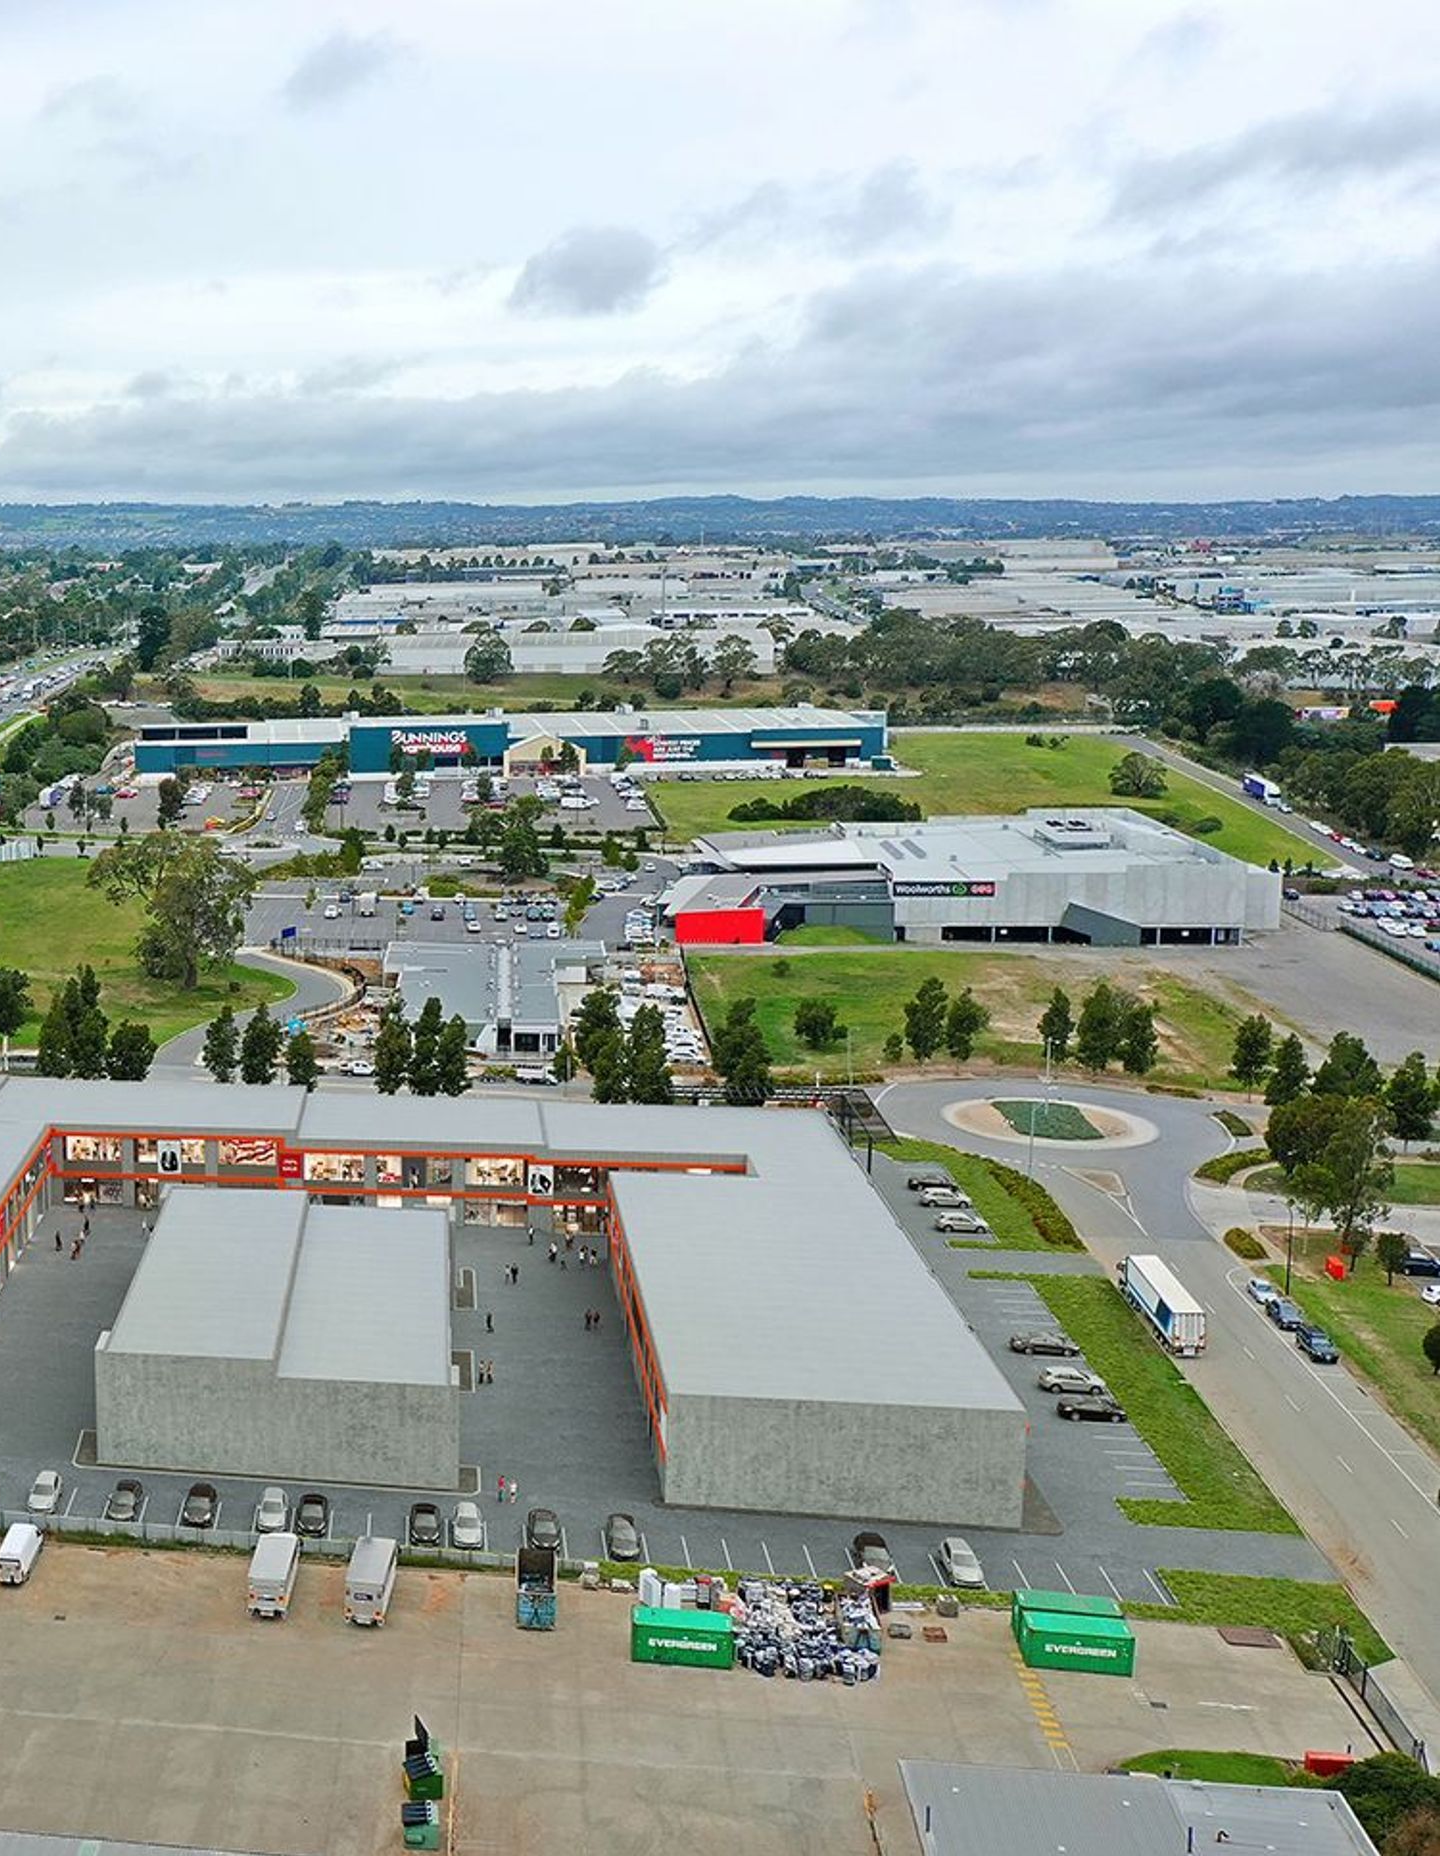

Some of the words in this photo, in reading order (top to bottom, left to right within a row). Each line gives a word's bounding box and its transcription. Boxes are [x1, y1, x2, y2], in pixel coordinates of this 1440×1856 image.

[391, 730, 467, 744] BUNNINGS
[895, 884, 951, 894] Woolworths
[648, 1637, 718, 1652] EVERGREEN
[1044, 1643, 1117, 1658] EVERGREEN
